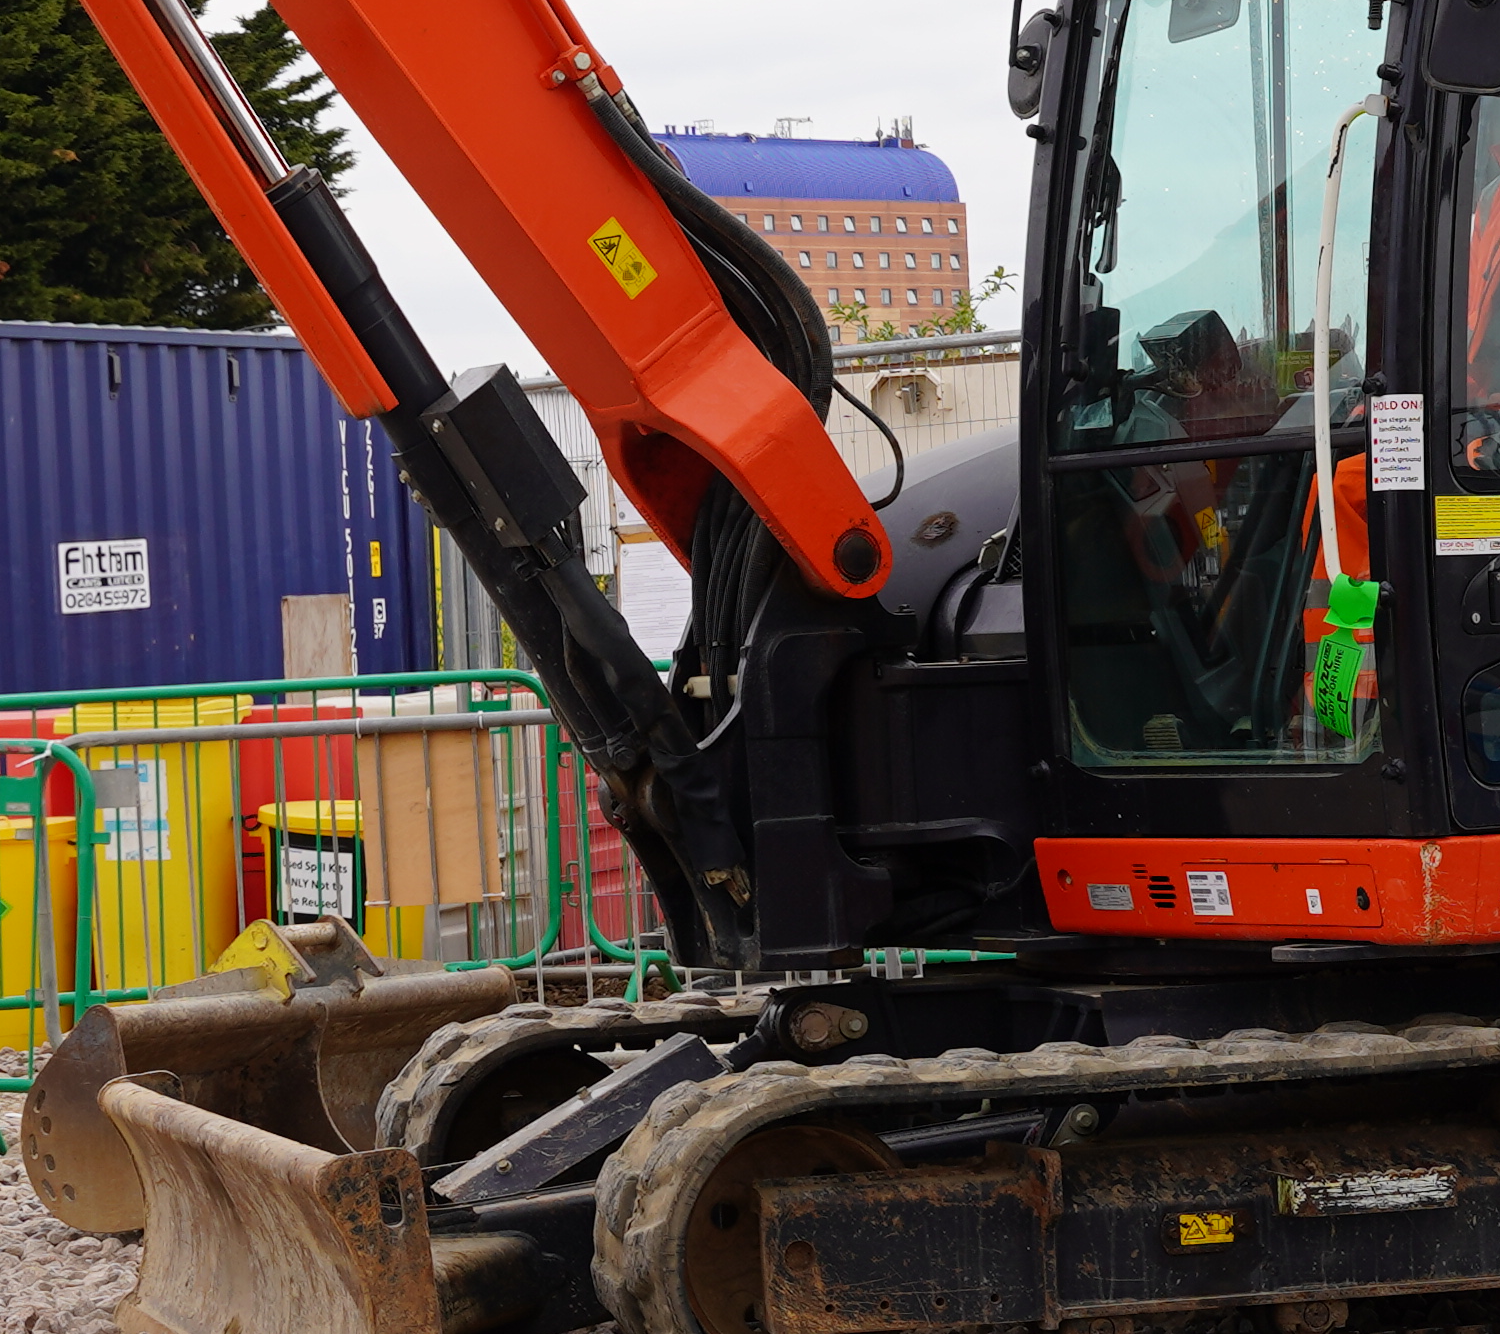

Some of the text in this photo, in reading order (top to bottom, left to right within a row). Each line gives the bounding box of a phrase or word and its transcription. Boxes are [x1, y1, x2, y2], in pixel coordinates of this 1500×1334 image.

[1373, 400, 1398, 411] HOLD
[338, 420, 350, 519] VICU
[1332, 649, 1344, 672] HIRE
[329, 863, 348, 874] Kts
[291, 878, 309, 888] NLY
